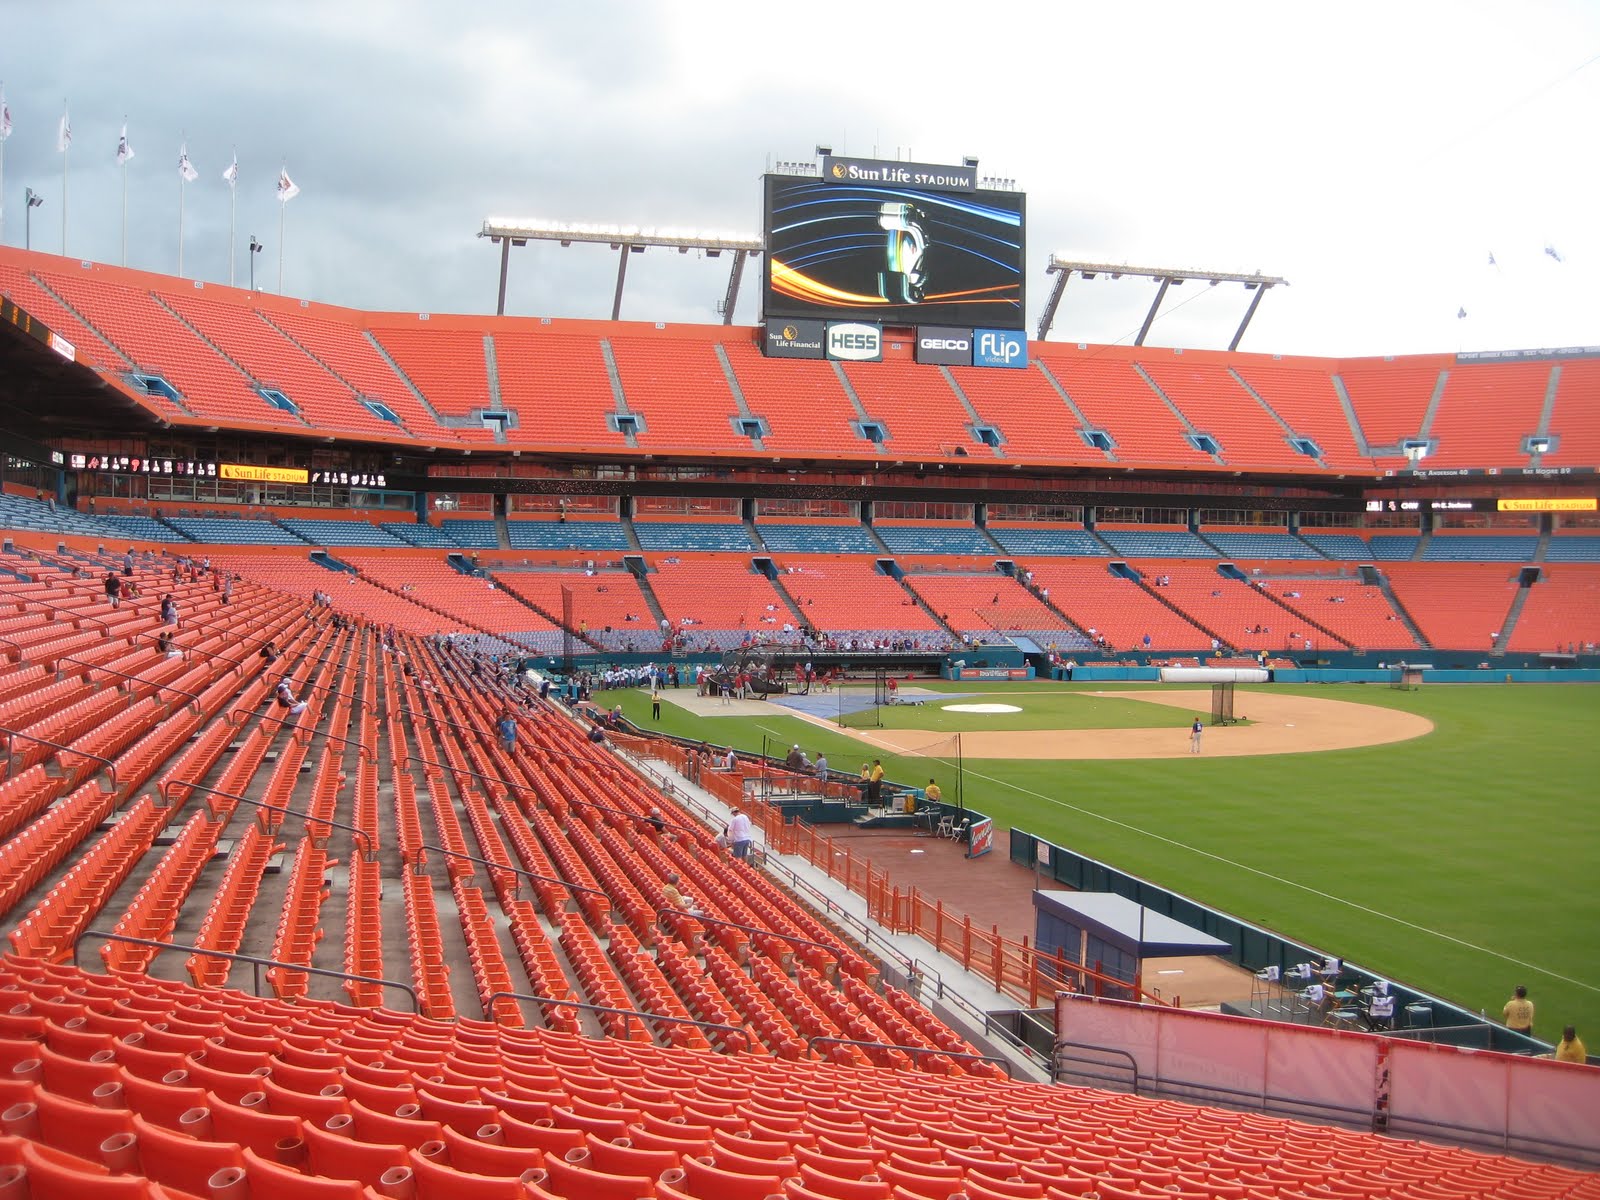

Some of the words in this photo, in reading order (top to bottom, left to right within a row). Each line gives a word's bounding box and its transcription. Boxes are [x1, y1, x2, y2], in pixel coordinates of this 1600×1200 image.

[849, 165, 879, 182] Sun
[882, 168, 911, 184] Life
[914, 174, 970, 188] STADIUM
[769, 332, 783, 340] Sun
[831, 332, 877, 350] HESS
[776, 339, 789, 348] Life
[789, 340, 821, 350] Financial
[920, 338, 969, 351] GEICO
[234, 467, 252, 478] Sun
[255, 469, 271, 480] Life
[273, 473, 305, 481] STADIUM
[1513, 501, 1532, 510] Sun
[1535, 501, 1554, 509] Life
